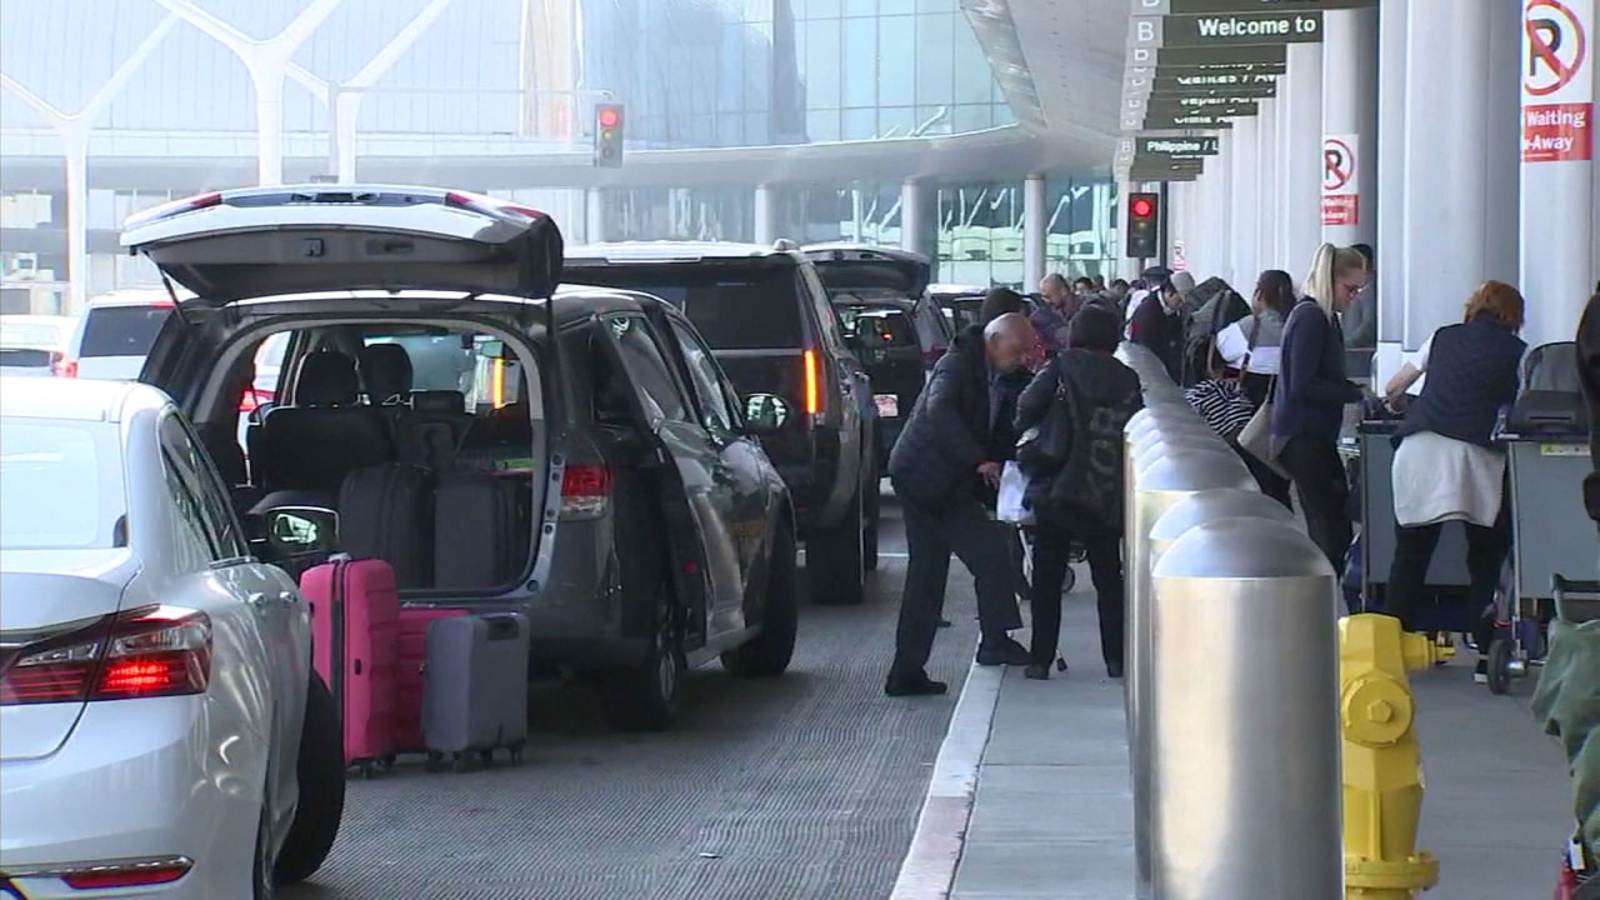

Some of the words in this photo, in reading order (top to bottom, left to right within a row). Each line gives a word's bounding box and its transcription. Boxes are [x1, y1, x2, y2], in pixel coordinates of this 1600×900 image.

[1137, 21, 1154, 41] B
[1198, 18, 1290, 36] Welcome
[1295, 15, 1317, 33] to
[1527, 110, 1586, 129] Waiting
